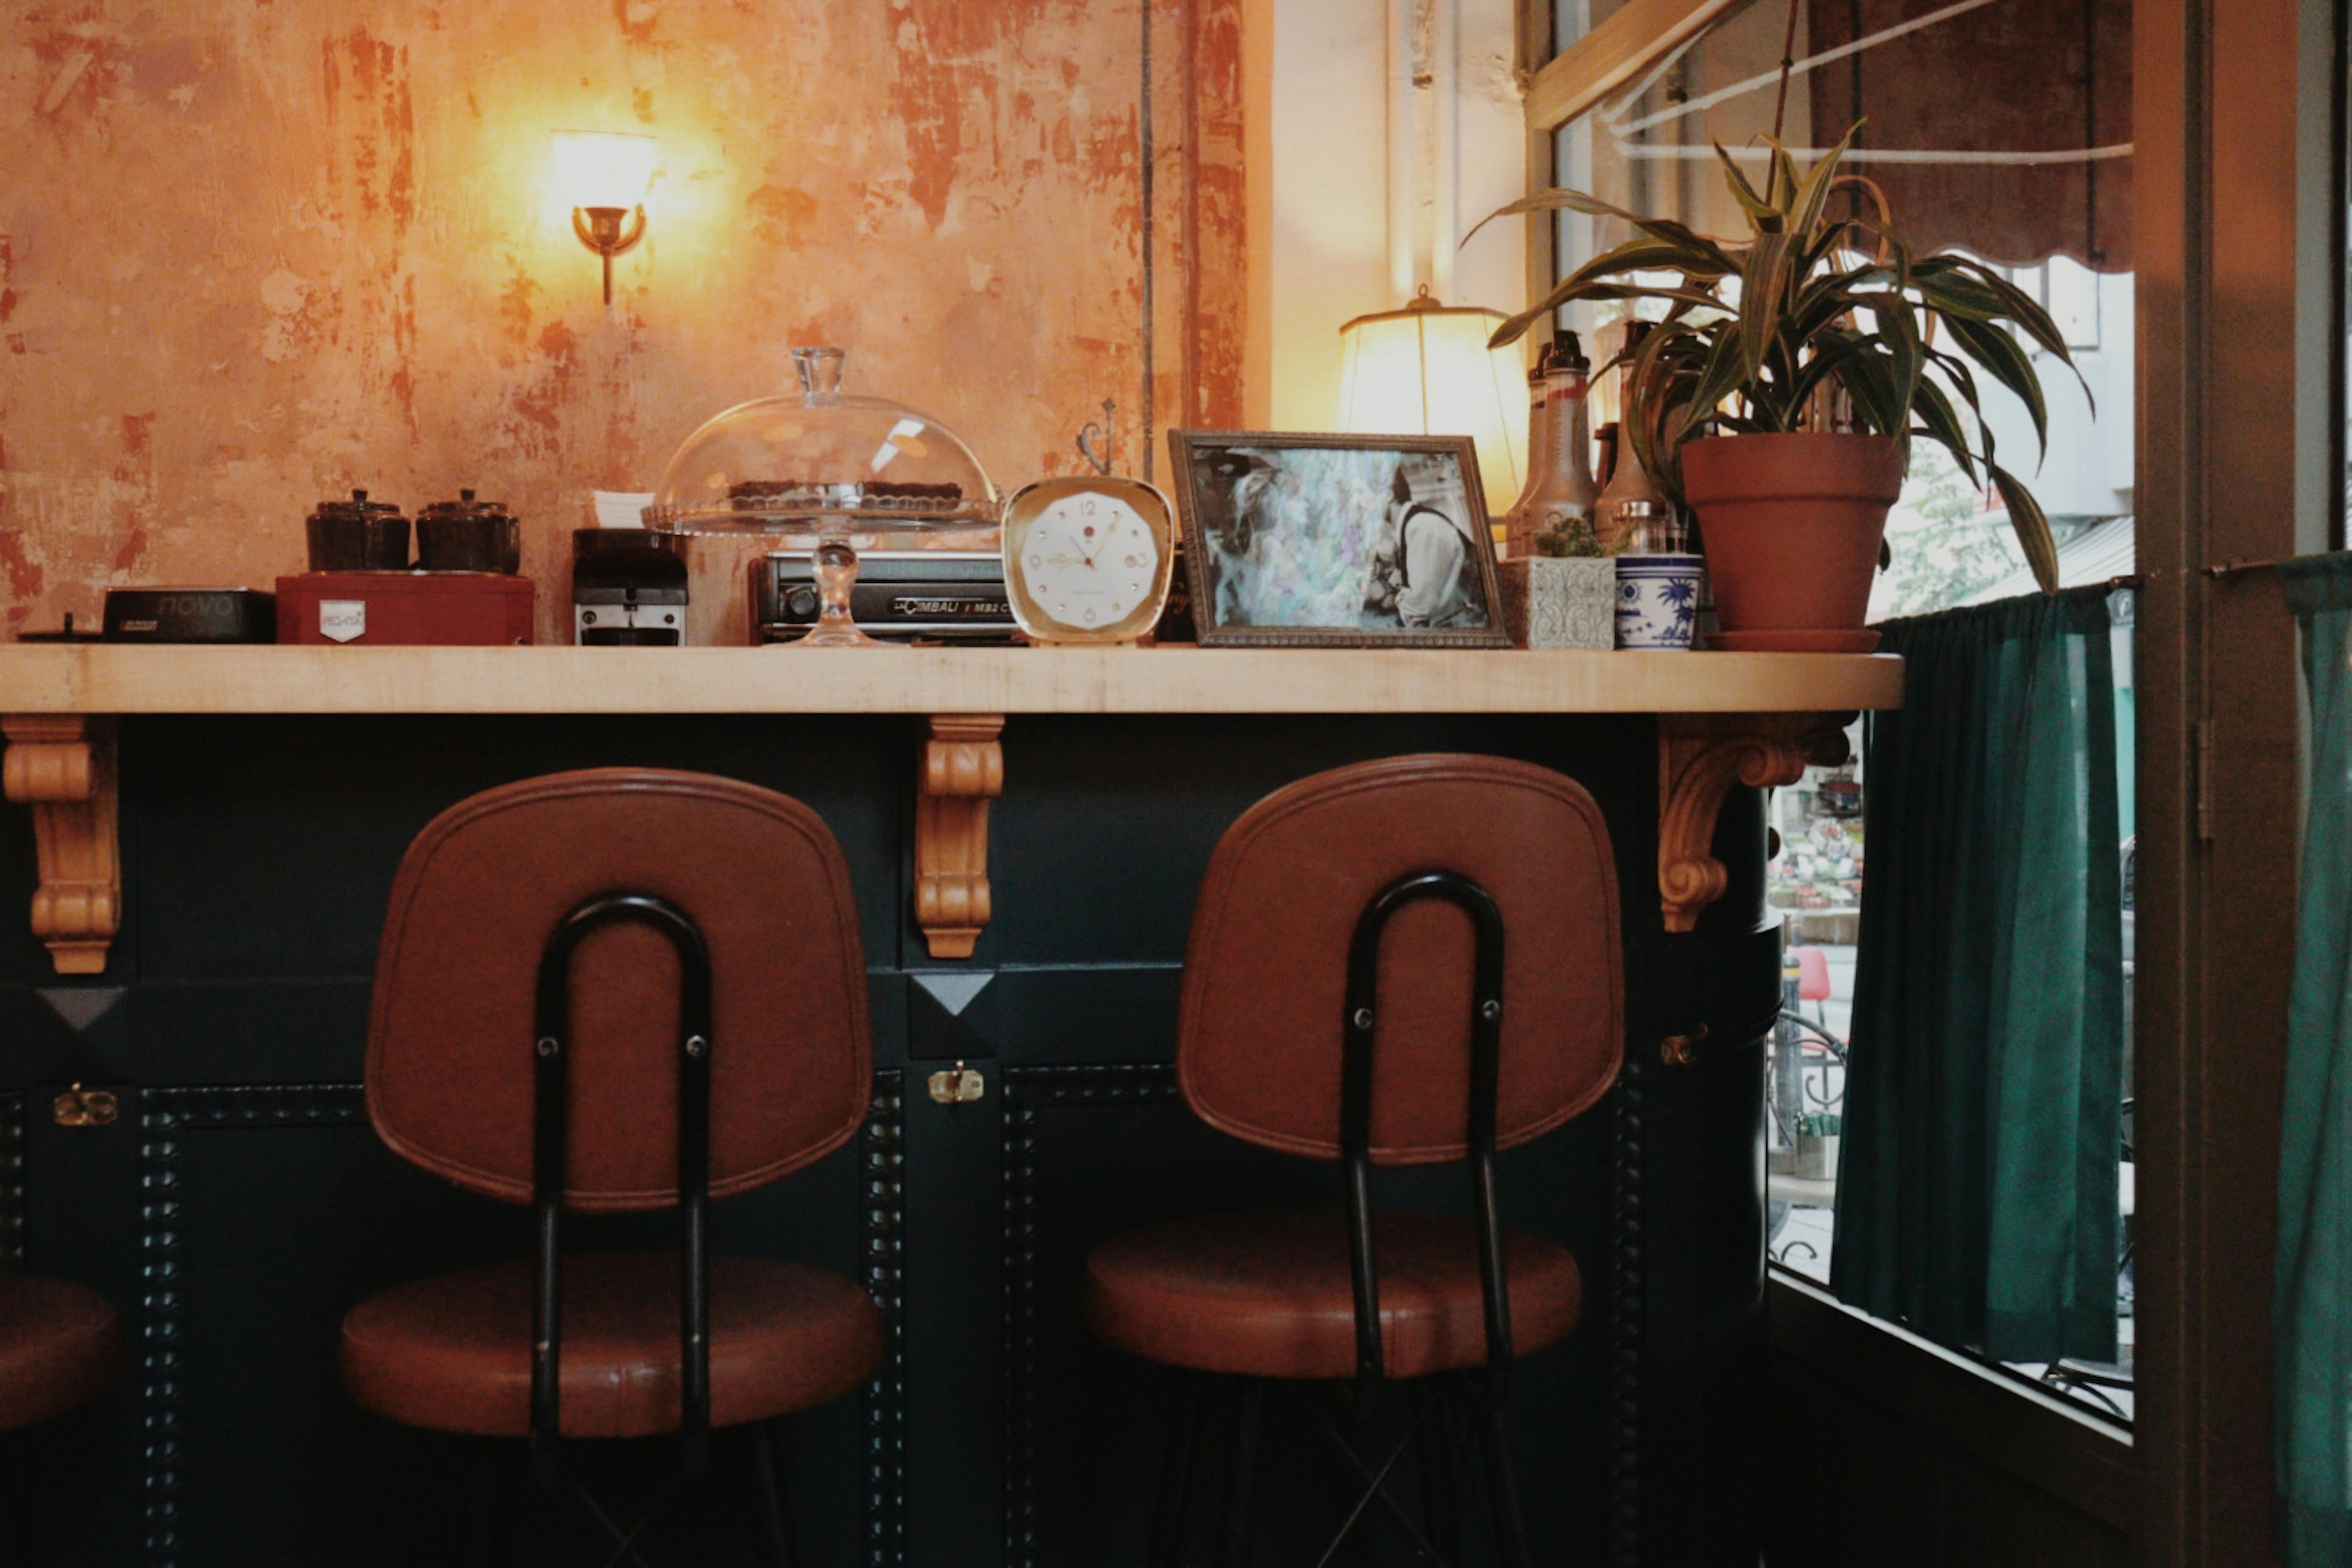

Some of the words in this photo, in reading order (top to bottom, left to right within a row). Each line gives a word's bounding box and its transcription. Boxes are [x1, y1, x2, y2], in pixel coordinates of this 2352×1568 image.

[1081, 500, 1096, 515] 12
[158, 596, 233, 615] novo
[1084, 607, 1097, 623] 6
